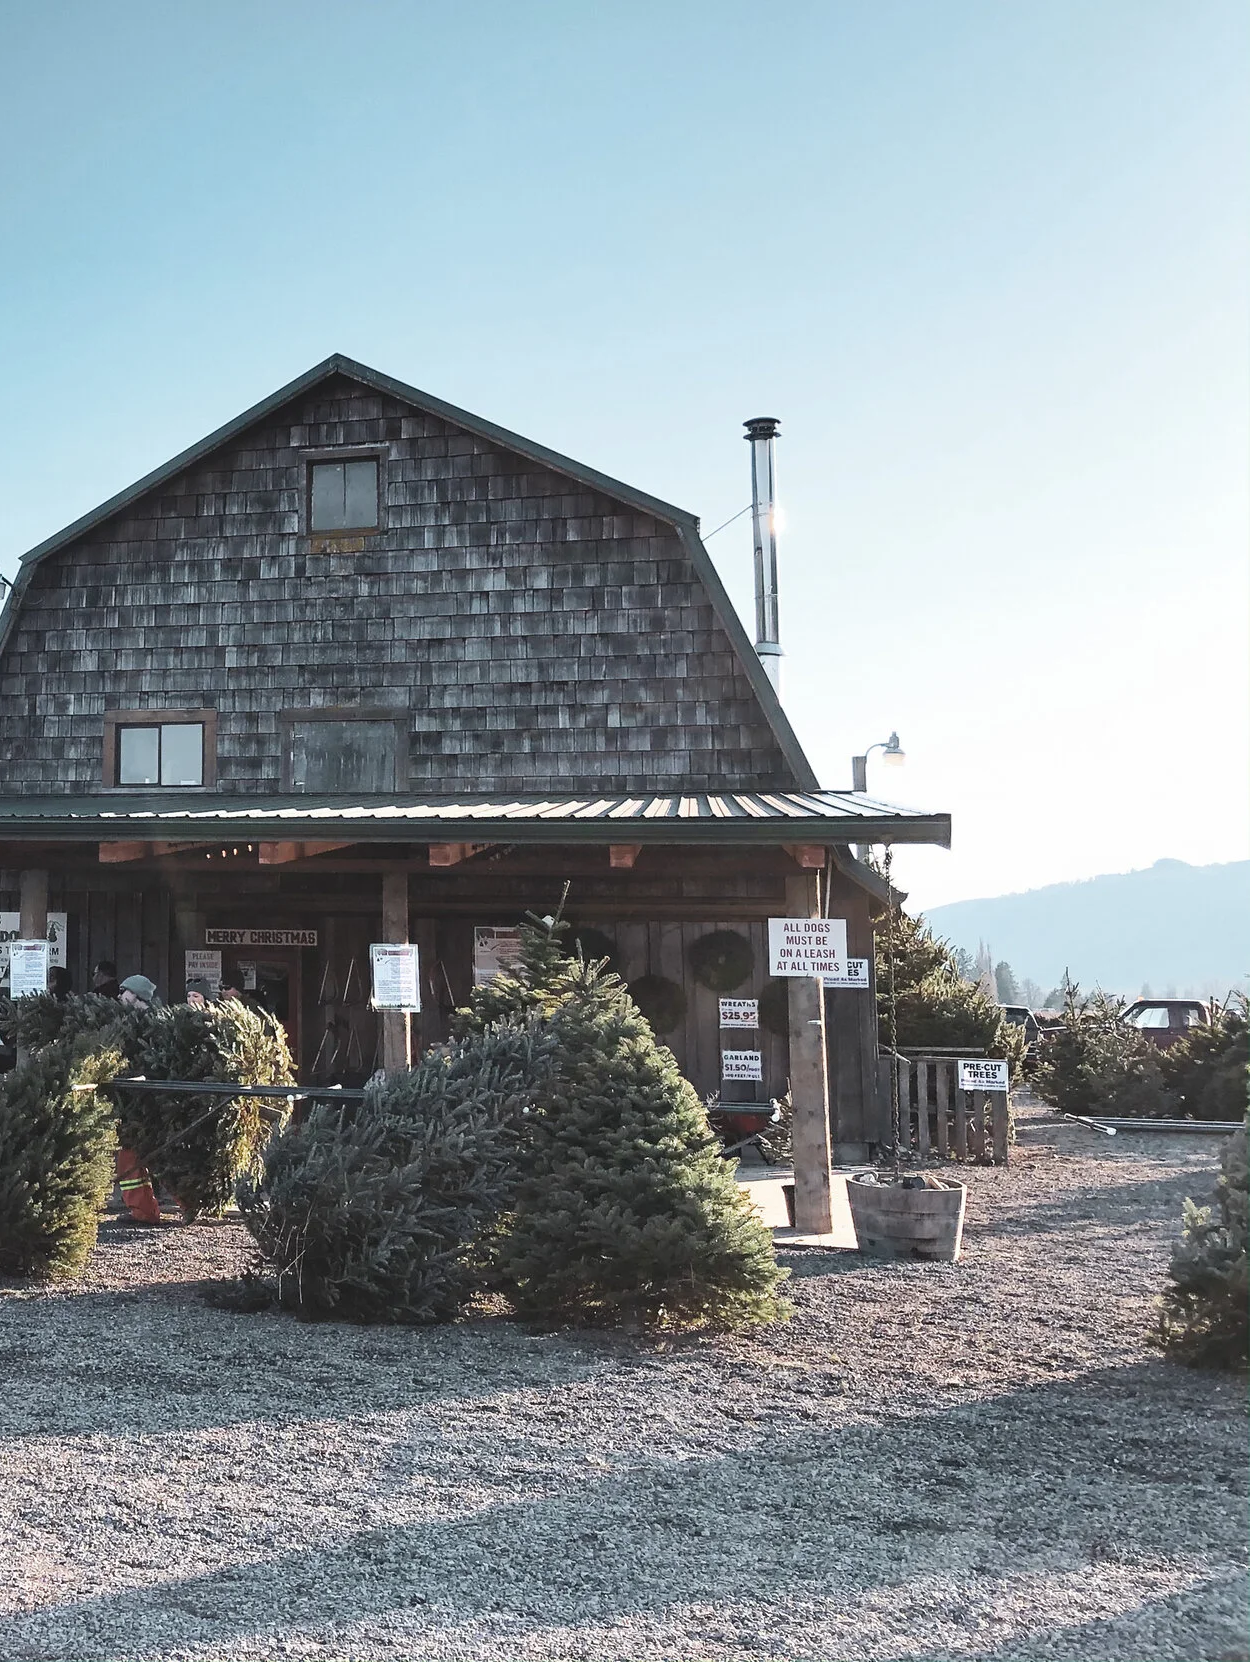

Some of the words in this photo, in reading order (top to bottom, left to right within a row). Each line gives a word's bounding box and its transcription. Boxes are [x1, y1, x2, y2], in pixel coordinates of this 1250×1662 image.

[783, 923, 801, 932] ALL
[804, 923, 831, 933] DOGS
[207, 931, 246, 943] MERRY
[250, 932, 316, 944] CHRISTMAS
[786, 936, 813, 946] MUST
[815, 936, 828, 946] BE
[780, 949, 793, 958] ON
[795, 949, 802, 958] A
[804, 949, 836, 959] LEASH
[188, 961, 199, 969] PAY
[776, 961, 788, 971] AT
[790, 962, 808, 971] ALL
[811, 962, 840, 972] TIMES
[722, 1011, 756, 1020] $25.95
[963, 1063, 1002, 1071] PRE-CUT
[968, 1071, 998, 1079] TREES
